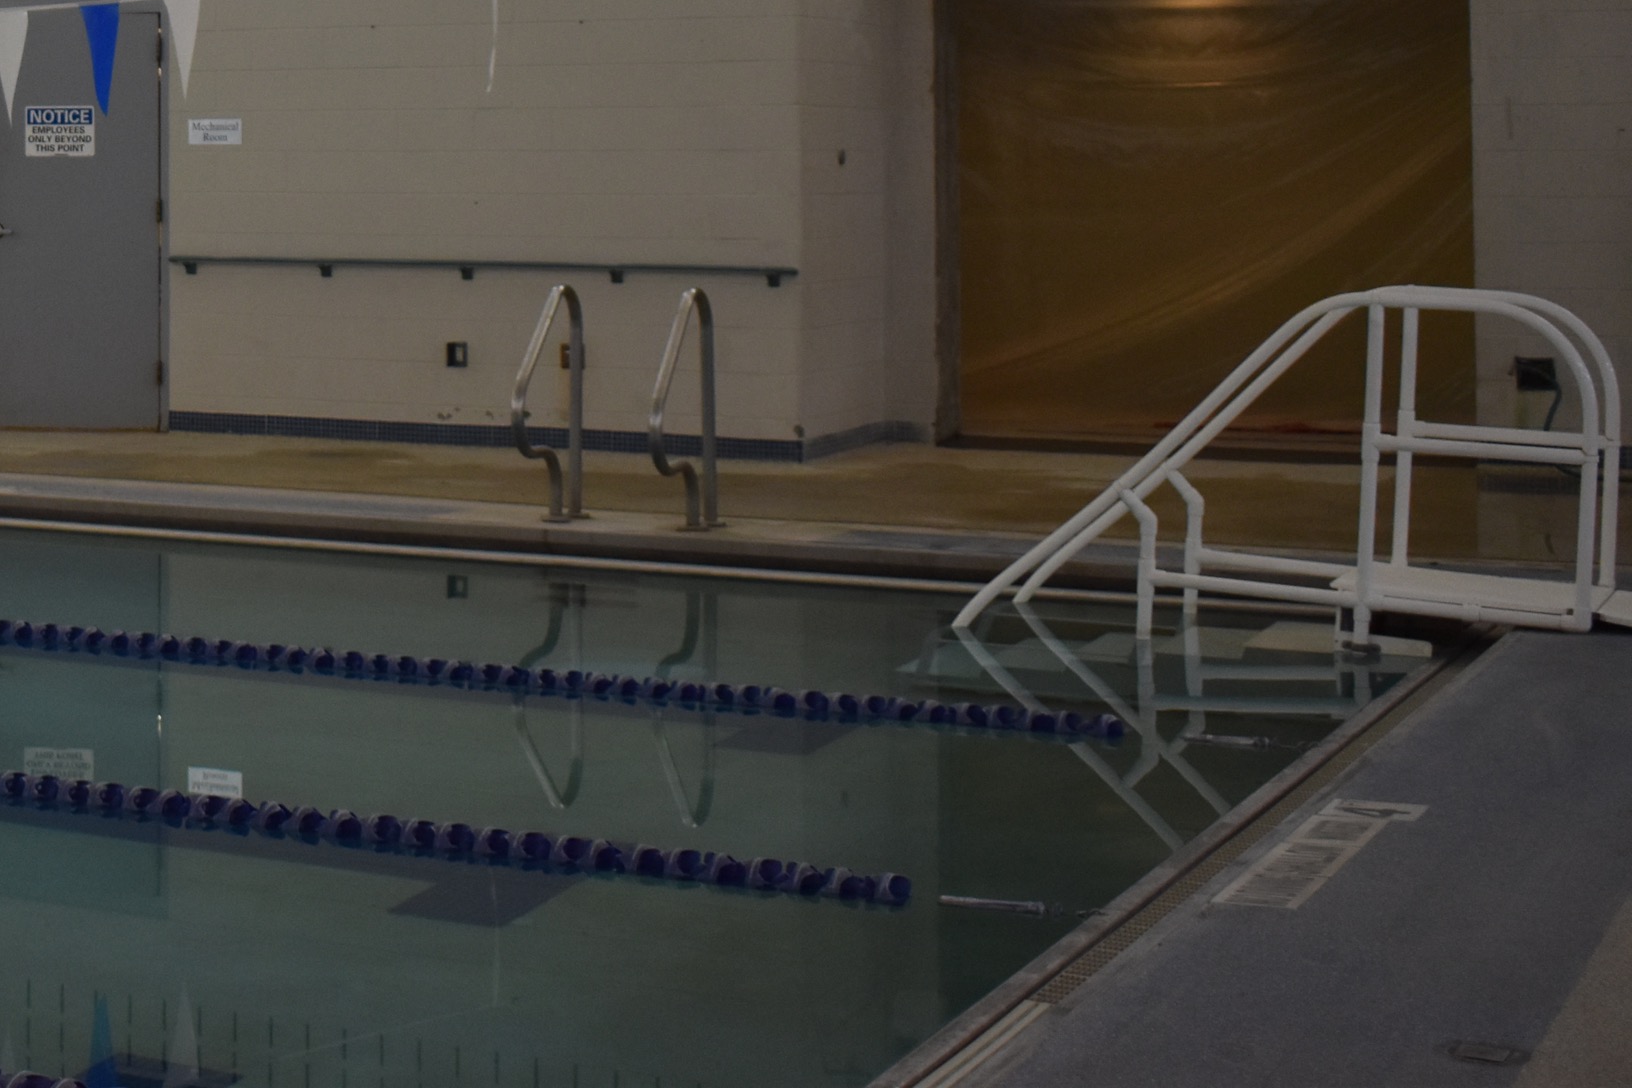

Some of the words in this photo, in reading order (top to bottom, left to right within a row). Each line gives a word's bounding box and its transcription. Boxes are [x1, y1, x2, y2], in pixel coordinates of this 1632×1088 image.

[29, 109, 90, 124] NOTICE
[32, 125, 86, 134] EMPLOYEES
[192, 121, 239, 131] Mechanical
[28, 134, 53, 143] ONLY
[54, 134, 92, 143] BEYOND
[203, 132, 228, 142] Room
[36, 143, 56, 152] THIS
[58, 143, 85, 152] POINT
